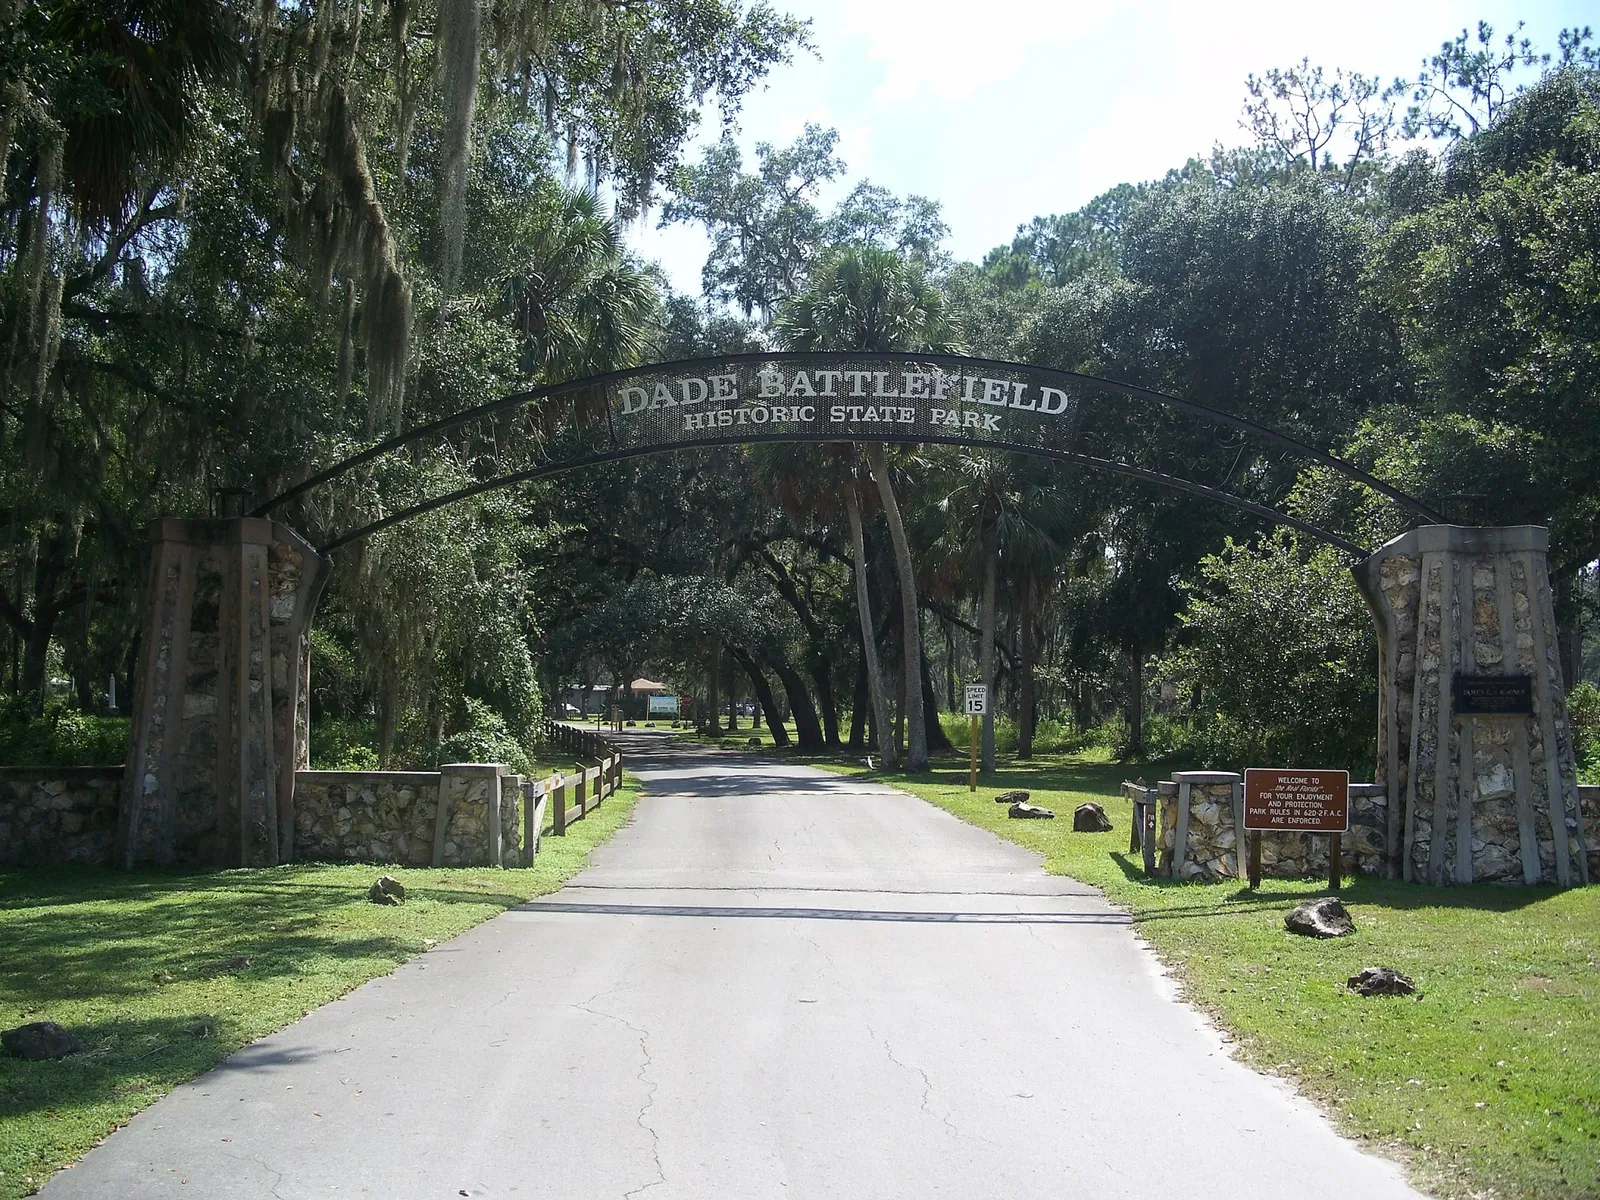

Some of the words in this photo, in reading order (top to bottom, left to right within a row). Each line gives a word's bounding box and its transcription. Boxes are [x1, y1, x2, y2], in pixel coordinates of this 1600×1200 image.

[618, 374, 738, 415] DADE
[757, 371, 1068, 415] BATTLEFIELD
[684, 406, 815, 430] HISTORIC
[830, 406, 915, 423] STATE
[930, 408, 1002, 431] PARK
[968, 700, 983, 712] 15
